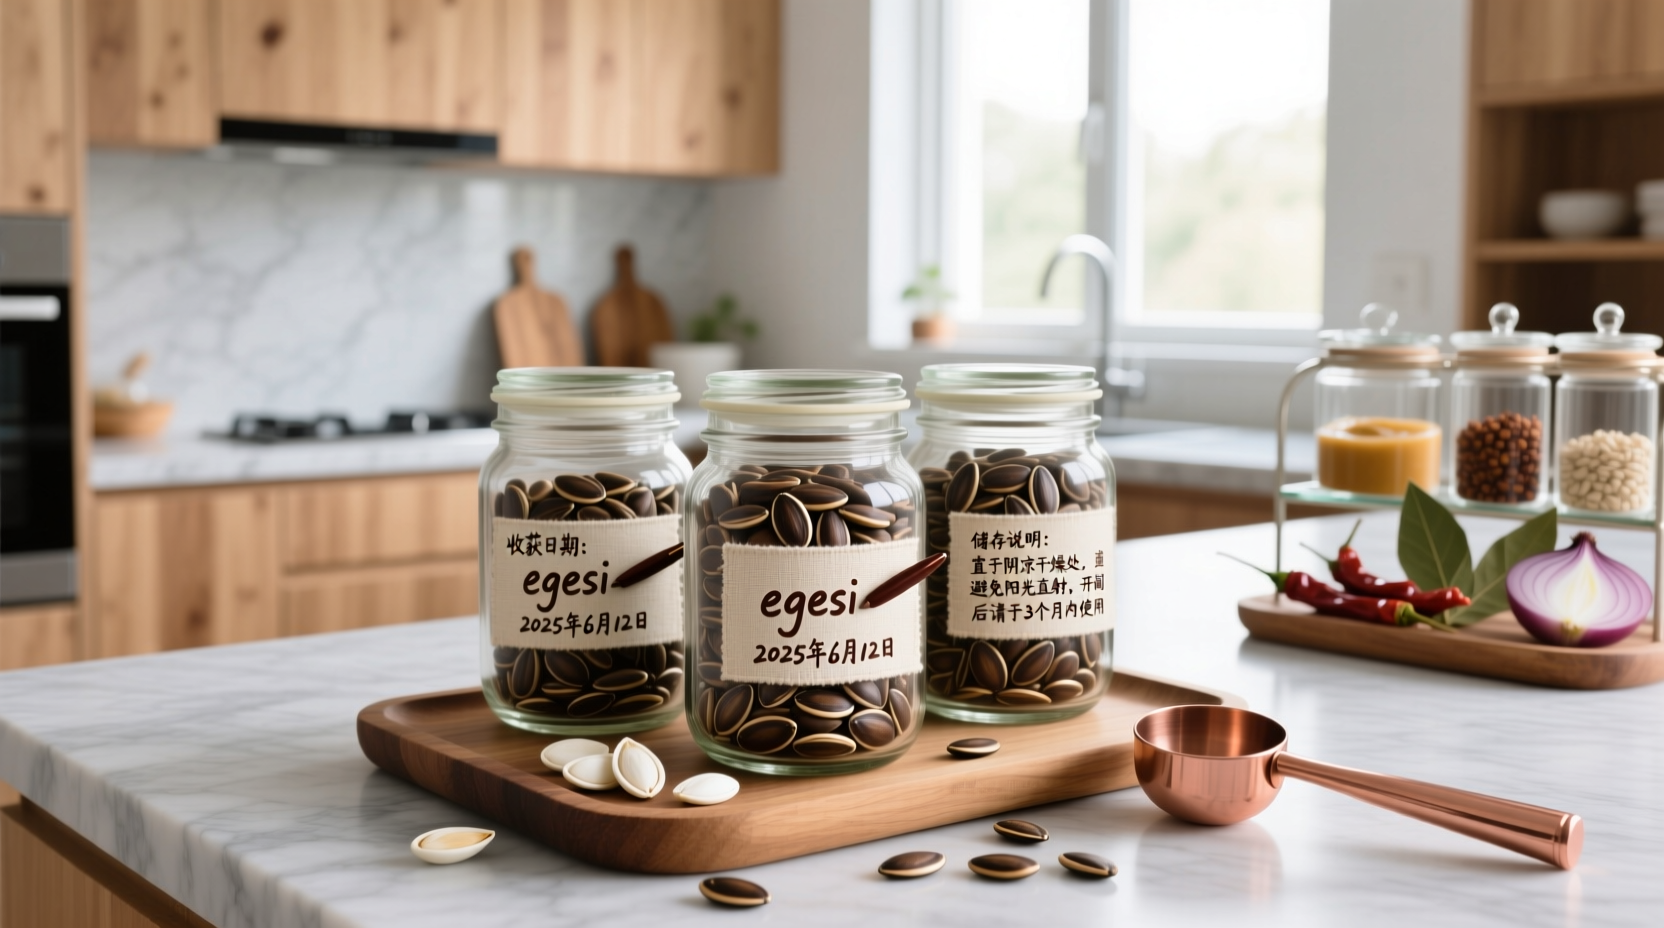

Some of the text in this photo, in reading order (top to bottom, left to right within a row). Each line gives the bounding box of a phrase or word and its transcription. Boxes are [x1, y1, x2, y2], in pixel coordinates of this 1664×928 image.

[506, 531, 587, 557] 收获日期：
[970, 530, 1049, 550] 储存说明：
[522, 560, 610, 613] egesi
[760, 578, 858, 638] egesi
[971, 597, 1104, 623] 后请于3个月内使用
[519, 611, 647, 639] 2025年6月12日
[753, 636, 894, 669] 2025年6月12日
